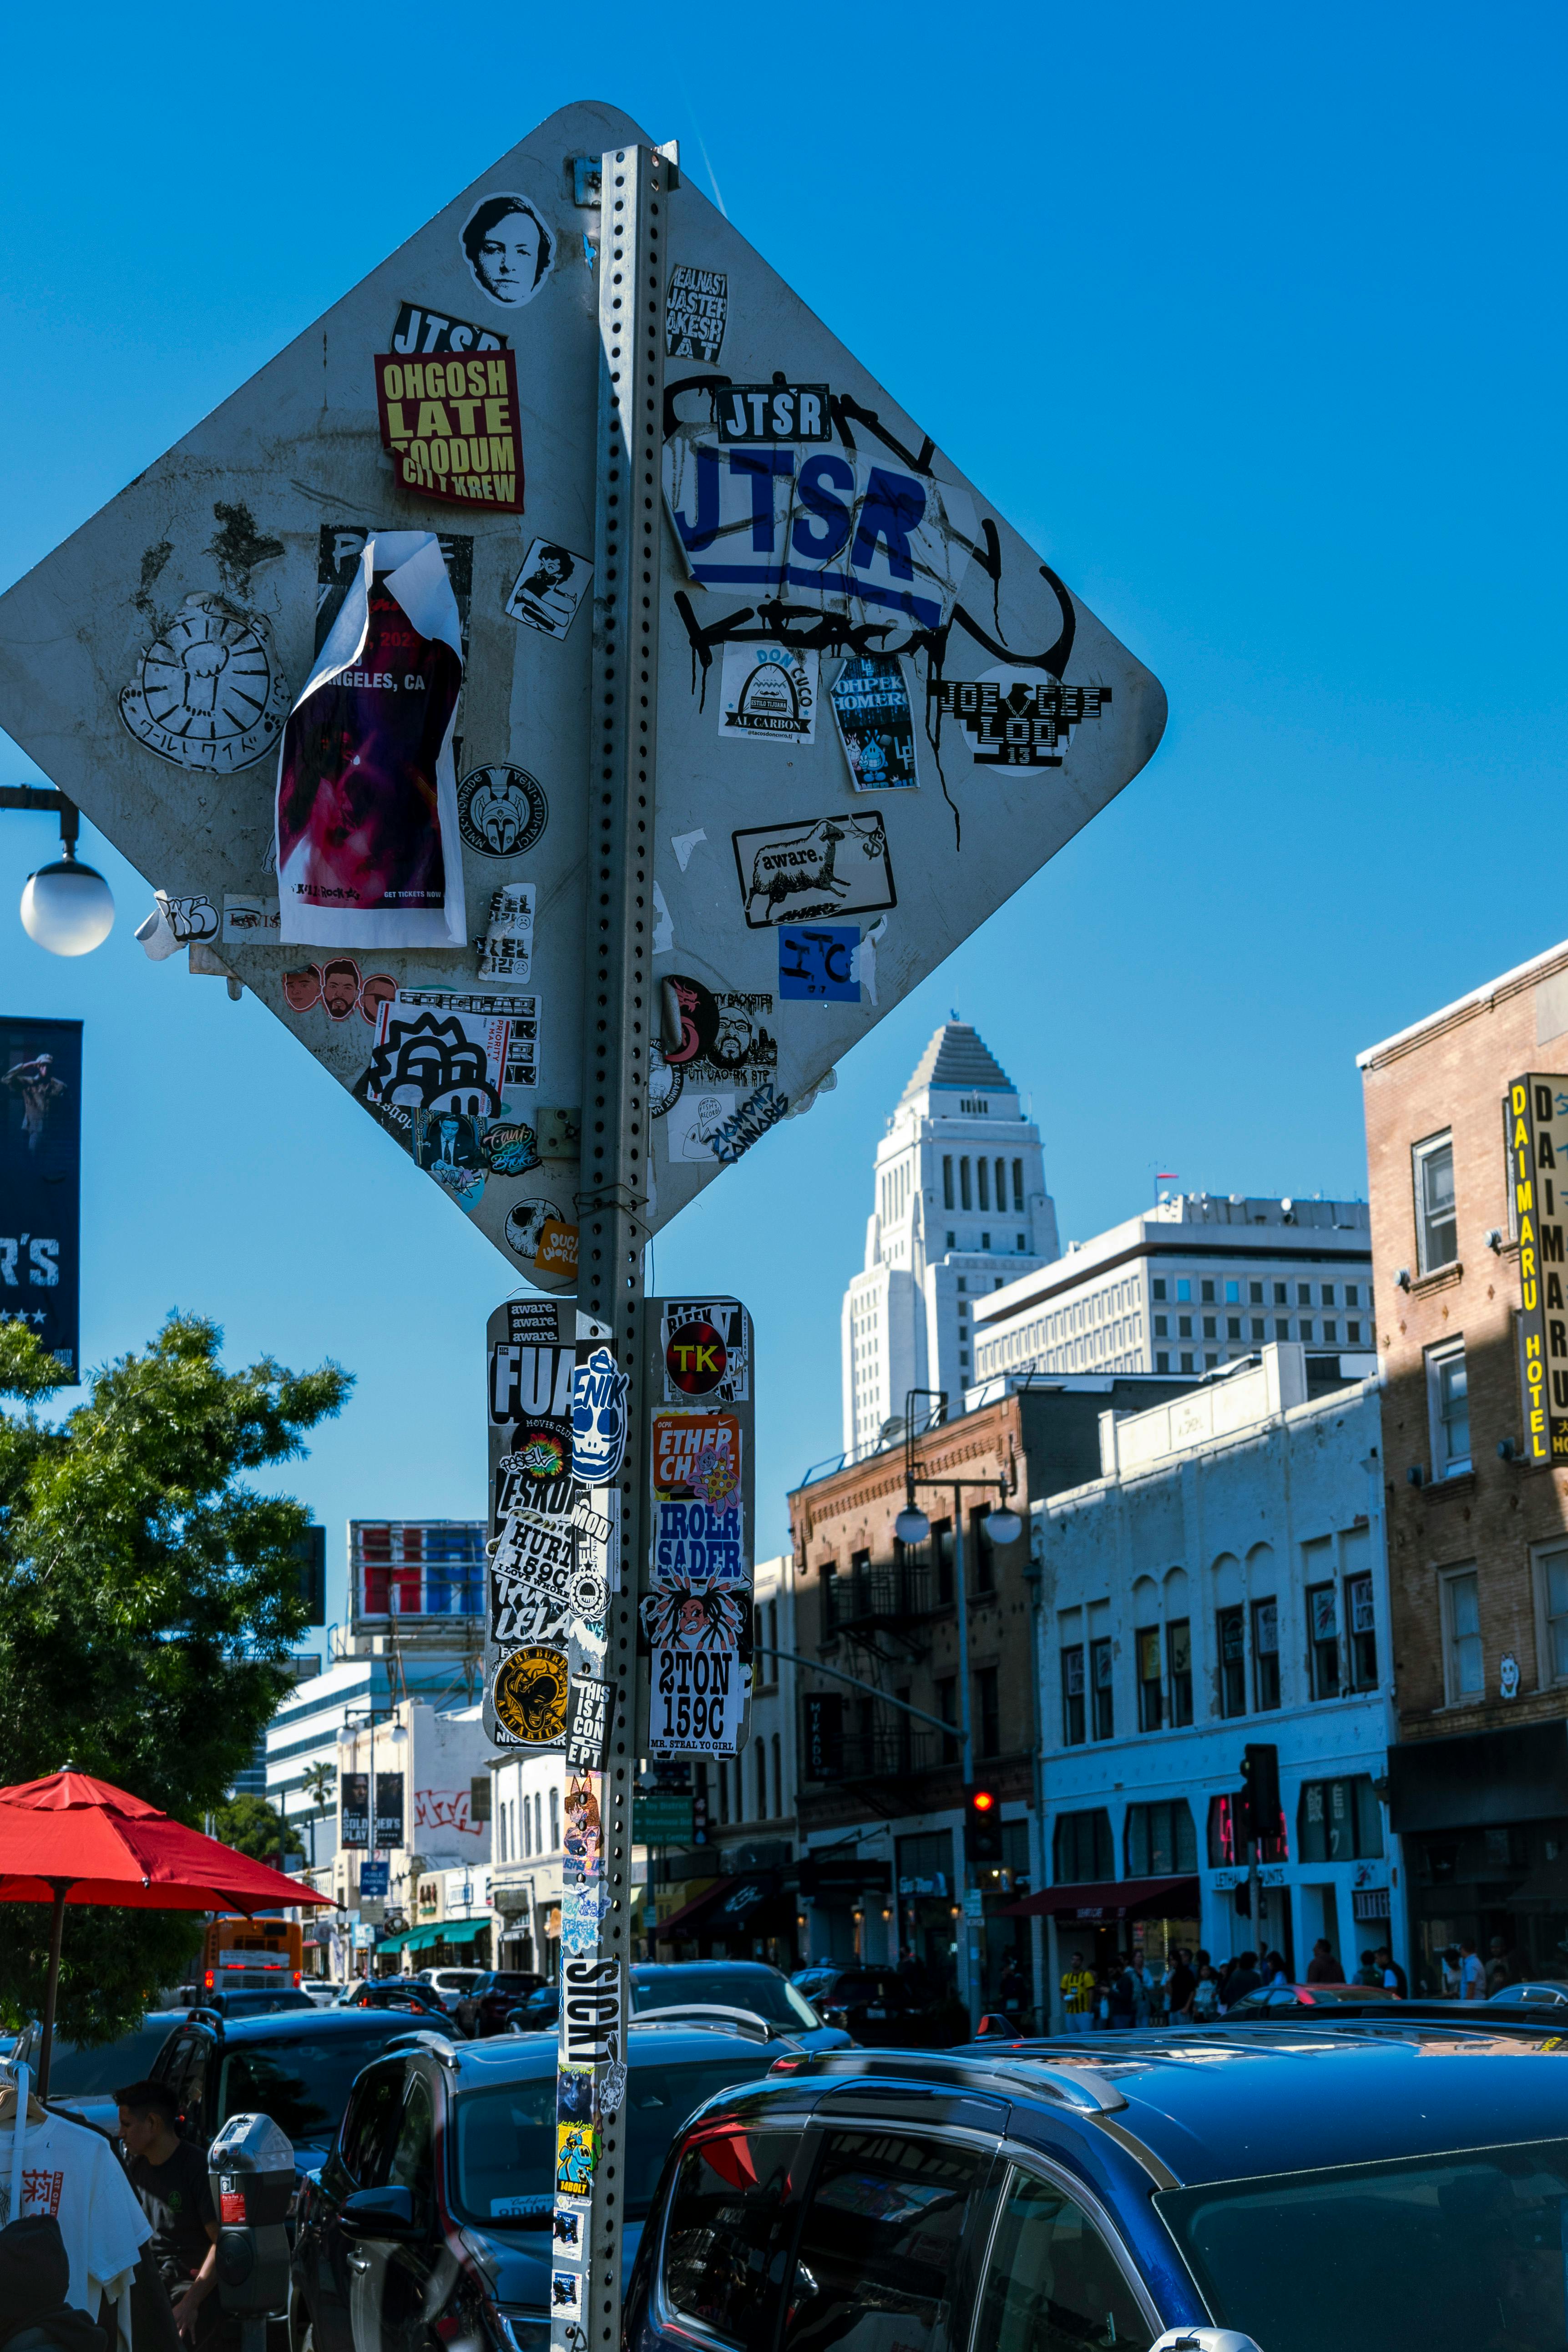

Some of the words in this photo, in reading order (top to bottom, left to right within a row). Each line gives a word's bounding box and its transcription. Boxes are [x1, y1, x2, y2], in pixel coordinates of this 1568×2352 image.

[383, 360, 508, 400] OHGOSH
[387, 398, 512, 438] LATE
[726, 394, 820, 436] JTSR
[451, 475, 515, 503] KREW
[673, 448, 926, 582] JTSR
[757, 648, 794, 668] DON
[328, 672, 398, 692] NGELES,
[405, 675, 425, 690] CA
[790, 668, 813, 708] CUCO
[751, 699, 766, 708] ESTILO
[767, 700, 786, 710] TIJUANA
[941, 683, 997, 713] JOE
[1038, 687, 1100, 716] GEE
[735, 716, 751, 726] AL
[754, 717, 802, 731] CARBON
[1007, 747, 1030, 764] 13
[458, 774, 482, 816] NOMADE
[514, 771, 537, 795] VENI
[533, 797, 543, 825] VIDI
[461, 821, 486, 848] MMIX
[516, 828, 538, 849] VICI
[762, 848, 824, 870] aware.
[493, 1019, 504, 1061] PRIORITY
[665, 1072, 681, 1107] AGAINST
[652, 1105, 664, 1114] HA
[416, 1108, 436, 1136] CORTE
[1534, 1085, 1568, 1410] DAIMARU
[1512, 1085, 1537, 1311] DAIMARU
[1526, 1334, 1546, 1457] HOTEL
[511, 1303, 556, 1315] aware.
[512, 1316, 557, 1328] aware.
[513, 1331, 557, 1342] aware.
[673, 1345, 720, 1372] TK
[574, 1368, 627, 1409] ENIK
[526, 1419, 555, 1430] MOVIE
[572, 1506, 610, 1542] MOD
[504, 1566, 531, 1582] LOVE
[510, 1551, 570, 1589] 159C
[506, 1650, 530, 1669] THE
[659, 1650, 732, 1695] 2TON
[580, 1681, 610, 1703] THIS
[497, 1700, 565, 1740] AQUARIUM
[577, 1697, 592, 1717] IS
[595, 1703, 606, 1722] A
[663, 1696, 724, 1739] 159C
[572, 1716, 603, 1741] CON
[810, 1701, 822, 1765] MIKADO
[669, 1740, 698, 1750] STEAL
[699, 1741, 711, 1750] YO
[712, 1741, 734, 1751] GIRL
[343, 1807, 349, 1818] A
[659, 1801, 688, 1810] District
[343, 1830, 367, 1841] PLAY
[646, 1834, 663, 1842] Civic
[666, 1833, 691, 1842] Center
[54, 2172, 62, 2189] ART
[561, 2181, 587, 2195] 14BOLT
[52, 2193, 59, 2204] OF
[511, 2197, 554, 2206] Califor
